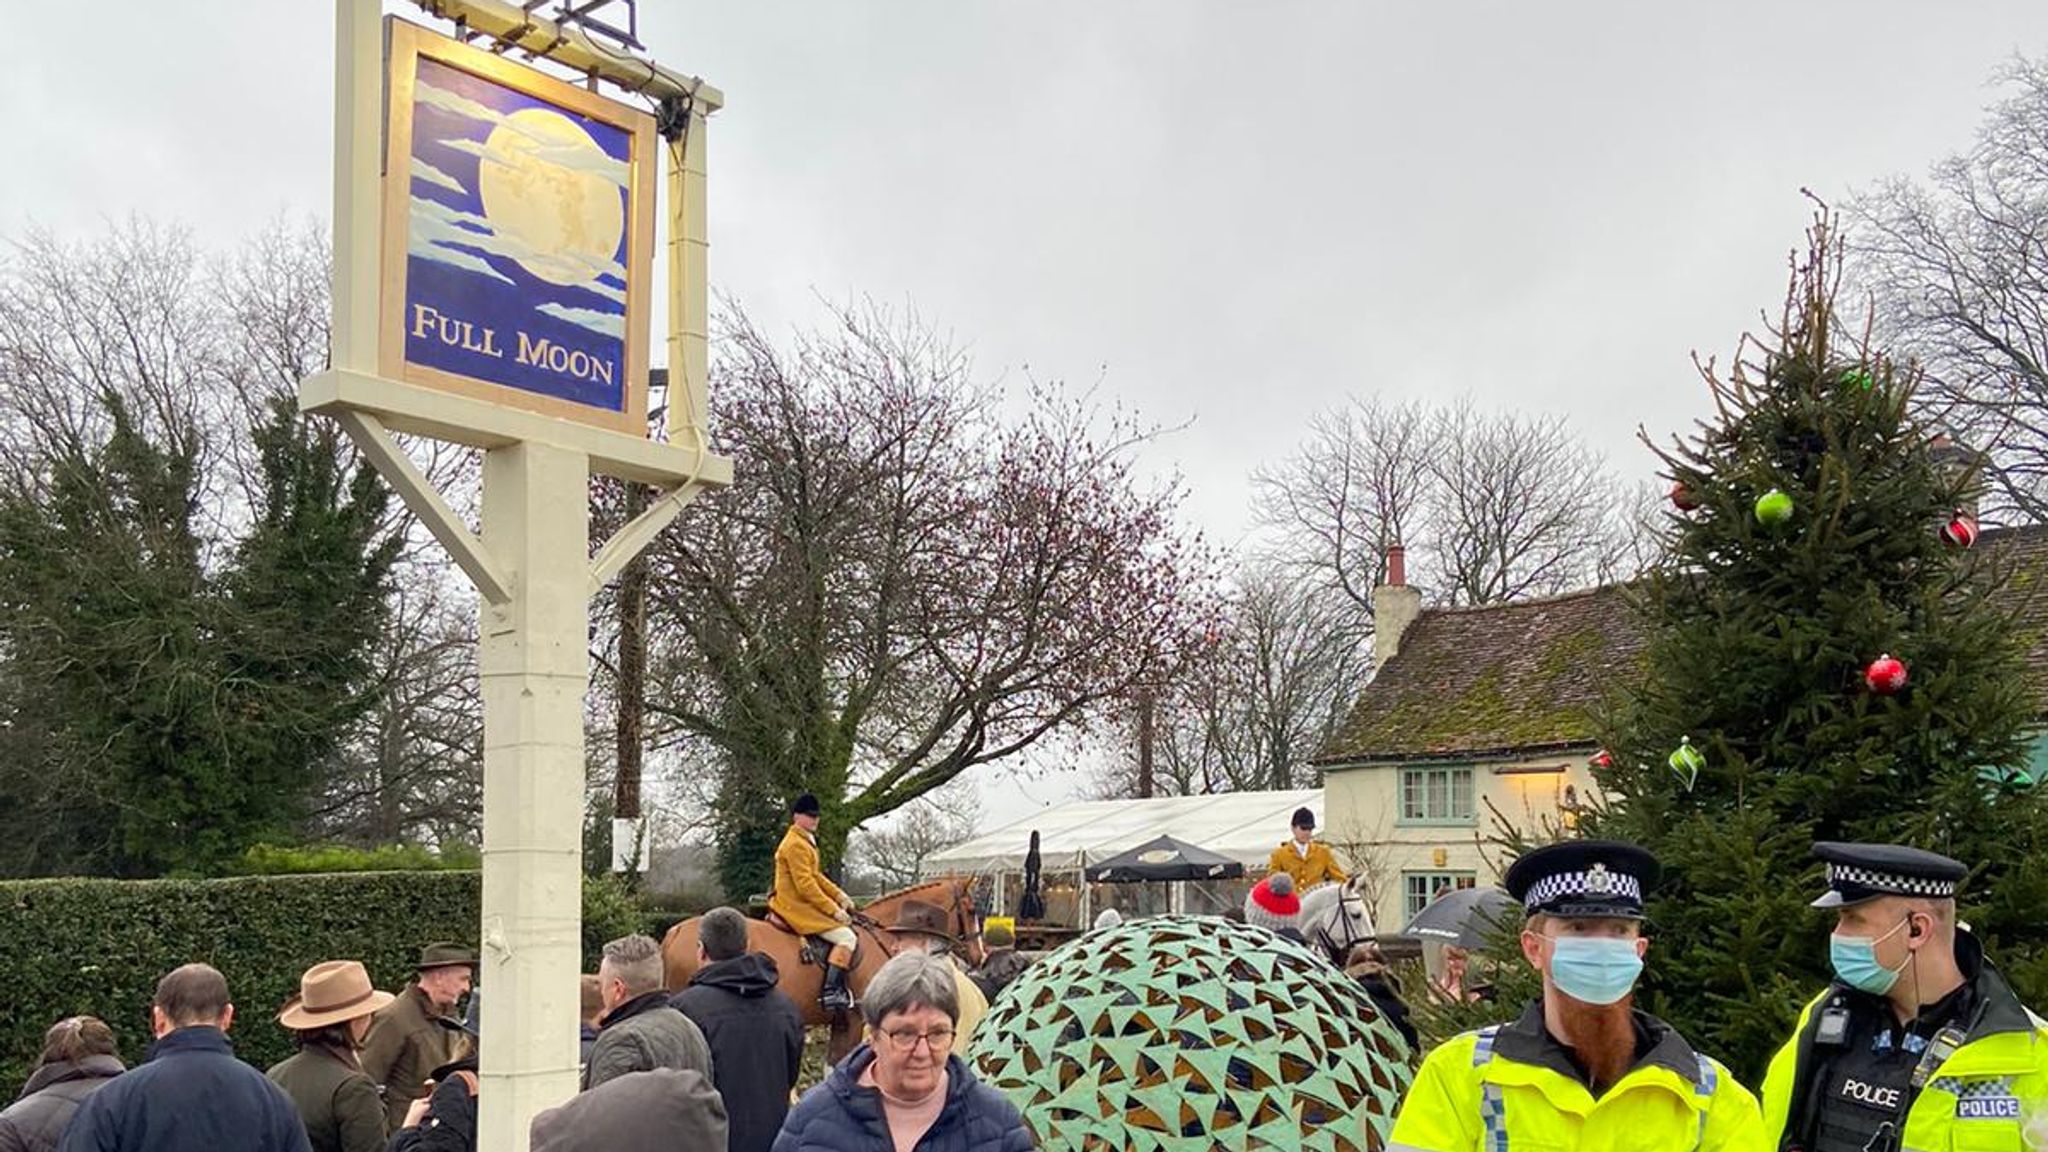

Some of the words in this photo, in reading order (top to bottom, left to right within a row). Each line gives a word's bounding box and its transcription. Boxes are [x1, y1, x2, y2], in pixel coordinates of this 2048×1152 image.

[412, 303, 503, 358] FULL
[515, 330, 614, 385] MOON
[1841, 1078, 1899, 1108] POLICE
[1959, 1099, 2018, 1117] POLICE
